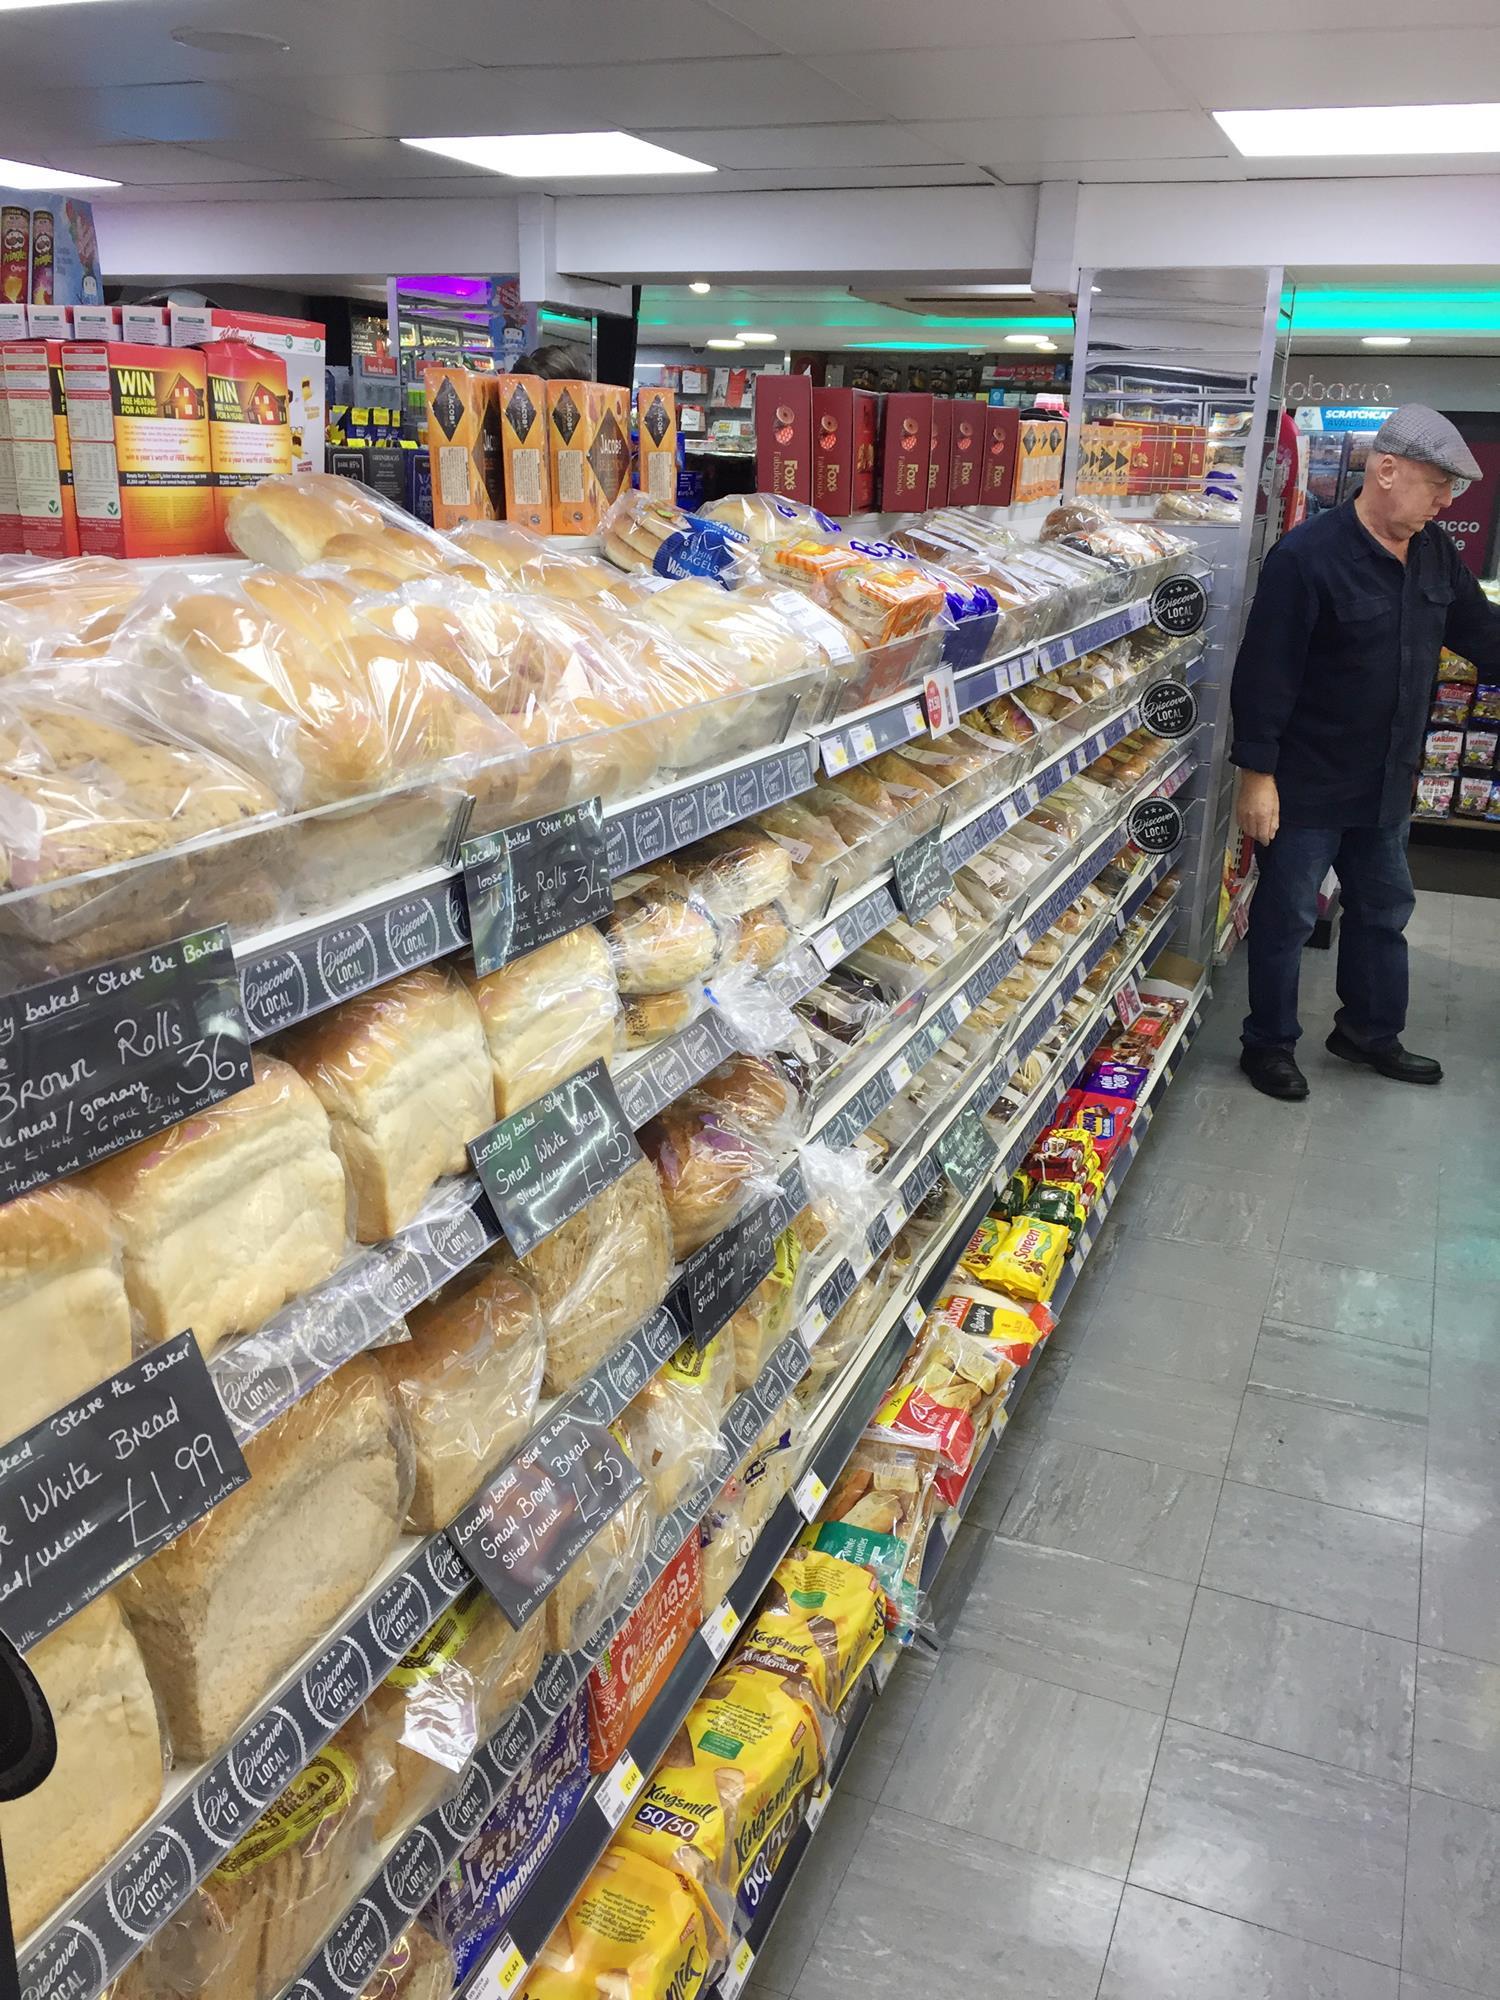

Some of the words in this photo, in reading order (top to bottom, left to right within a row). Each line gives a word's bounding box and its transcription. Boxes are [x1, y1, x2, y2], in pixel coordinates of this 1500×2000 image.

[117, 370, 155, 396] WIN
[212, 379, 239, 404] WIN
[1287, 373, 1392, 402] obacco
[121, 406, 133, 414] FOR
[1325, 409, 1393, 420] SCRATCHCA
[1436, 520, 1481, 534] acco
[680, 551, 720, 574] BAGELS
[1154, 589, 1201, 614] Discover
[1167, 606, 1194, 620] LOCAL
[1142, 695, 1189, 719] Discover
[1156, 709, 1184, 722] LOCAL
[505, 828, 531, 849] baked
[563, 813, 577, 828] the
[1131, 812, 1176, 836] Discover
[1144, 826, 1170, 838] LOCAL
[536, 866, 568, 891] Rolls
[390, 910, 430, 946] Discover
[402, 933, 428, 955] LOCAL
[323, 934, 366, 978] Discover
[337, 962, 365, 984] LOCAL
[25, 985, 80, 1021] baked
[149, 954, 177, 975] the
[245, 964, 297, 1011] Discover
[260, 991, 294, 1018] LOCAL
[114, 1011, 183, 1065] Rolls
[80, 1081, 152, 1122] granary
[113, 1108, 140, 1126] pack
[473, 1132, 514, 1165] Locally
[513, 1112, 537, 1136] baked
[495, 1158, 532, 1195] Small
[534, 1135, 569, 1164] White
[572, 1106, 602, 1136] Bread
[57, 1156, 80, 1173] and
[431, 1214, 467, 1251] Discover
[447, 1233, 474, 1254] LOCAL
[1013, 1228, 1041, 1260] Soreen
[693, 1269, 716, 1299] Large
[718, 1242, 739, 1270] Brown
[742, 1212, 764, 1244] Bread
[388, 1272, 418, 1301] LOCAL
[320, 1323, 352, 1351] LOCAL
[656, 1331, 674, 1351] LOCAL
[110, 1379, 136, 1398] the
[243, 1377, 281, 1411] LOCAL
[622, 1367, 640, 1388] LOCAL
[20, 1461, 103, 1523] White
[108, 1396, 180, 1461] Bread
[117, 1433, 225, 1548] £1.99
[480, 1515, 520, 1559] Small
[516, 1476, 556, 1519] Brown
[550, 1432, 592, 1478] Bread
[572, 1448, 624, 1523] £1.35
[454, 1502, 494, 1546] Locally
[490, 1476, 518, 1504] baked
[658, 1529, 675, 1552] LOCAL
[842, 1537, 857, 1557] White
[46, 1602, 75, 1627] and
[373, 1582, 414, 1643] Discover
[390, 1606, 420, 1641] LOCAL
[515, 1598, 533, 1623] from
[749, 1628, 813, 1657] Kingsmill
[311, 1645, 354, 1714] Discover
[327, 1672, 360, 1710] LOCAL
[537, 1655, 563, 1702] Discover
[549, 1673, 570, 1701] LOCAL
[492, 1706, 522, 1761] Discover
[504, 1730, 528, 1761] LOCAL
[238, 1716, 285, 1788] Discover
[255, 1746, 291, 1786] LOCAL
[444, 1766, 477, 1826] Discover
[457, 1791, 482, 1825] LOCAL
[644, 1783, 718, 1823] Kingsmill
[733, 1745, 807, 1873] Kingsmill
[638, 1805, 695, 1838] 50/50
[121, 1836, 173, 1920] Discover
[392, 1833, 427, 1898] Discover
[406, 1860, 433, 1895] LOCAL
[496, 1806, 560, 1918] Warburtons
[137, 1870, 179, 1917] LOCAL
[333, 1908, 371, 1977] Discover
[348, 1936, 377, 1973] LOCAL
[504, 1960, 520, 1983] £1.44
